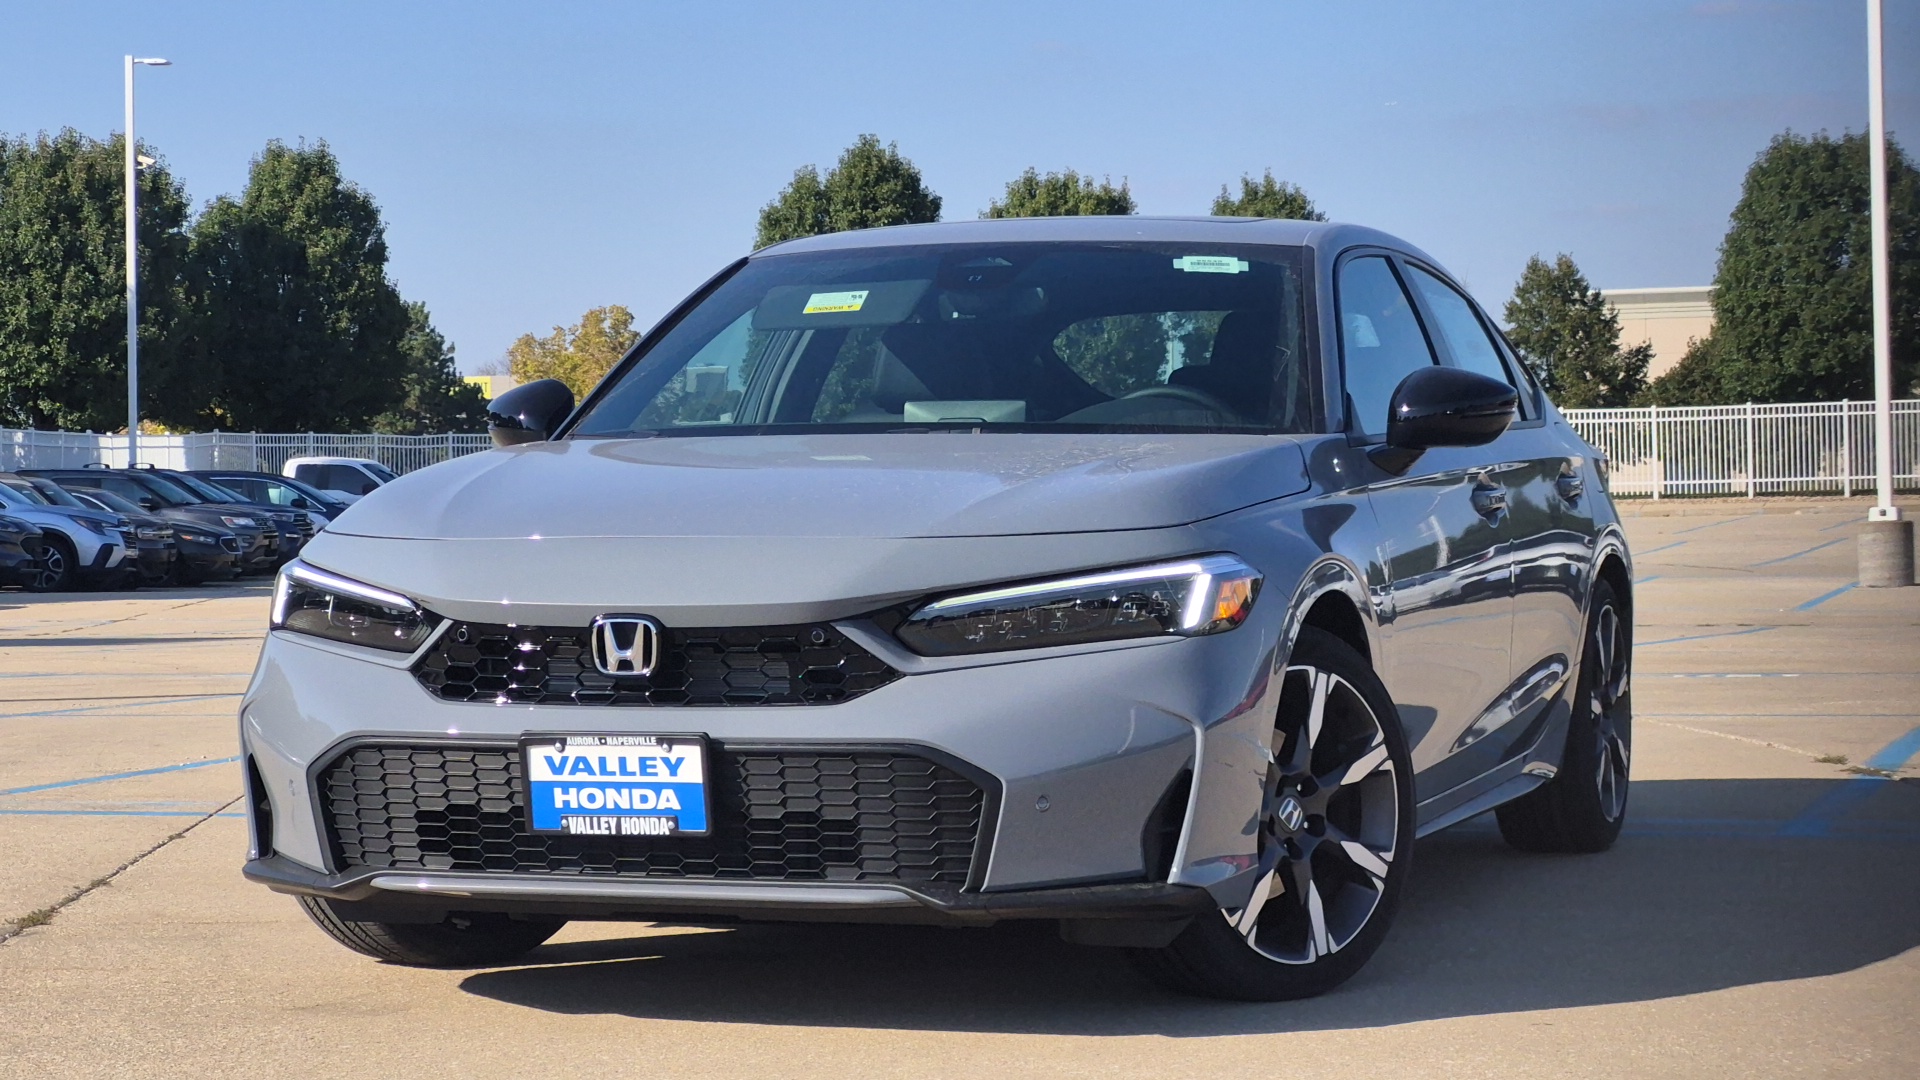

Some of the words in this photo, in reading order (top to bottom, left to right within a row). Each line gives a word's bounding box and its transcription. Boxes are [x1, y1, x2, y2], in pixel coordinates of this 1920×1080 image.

[566, 737, 600, 746] AURORA
[606, 737, 657, 746] NAPERVILLE
[543, 755, 686, 777] VALLEY
[553, 787, 682, 810] HONDA
[568, 816, 618, 835] VALLEY
[621, 817, 670, 836] HONDA
